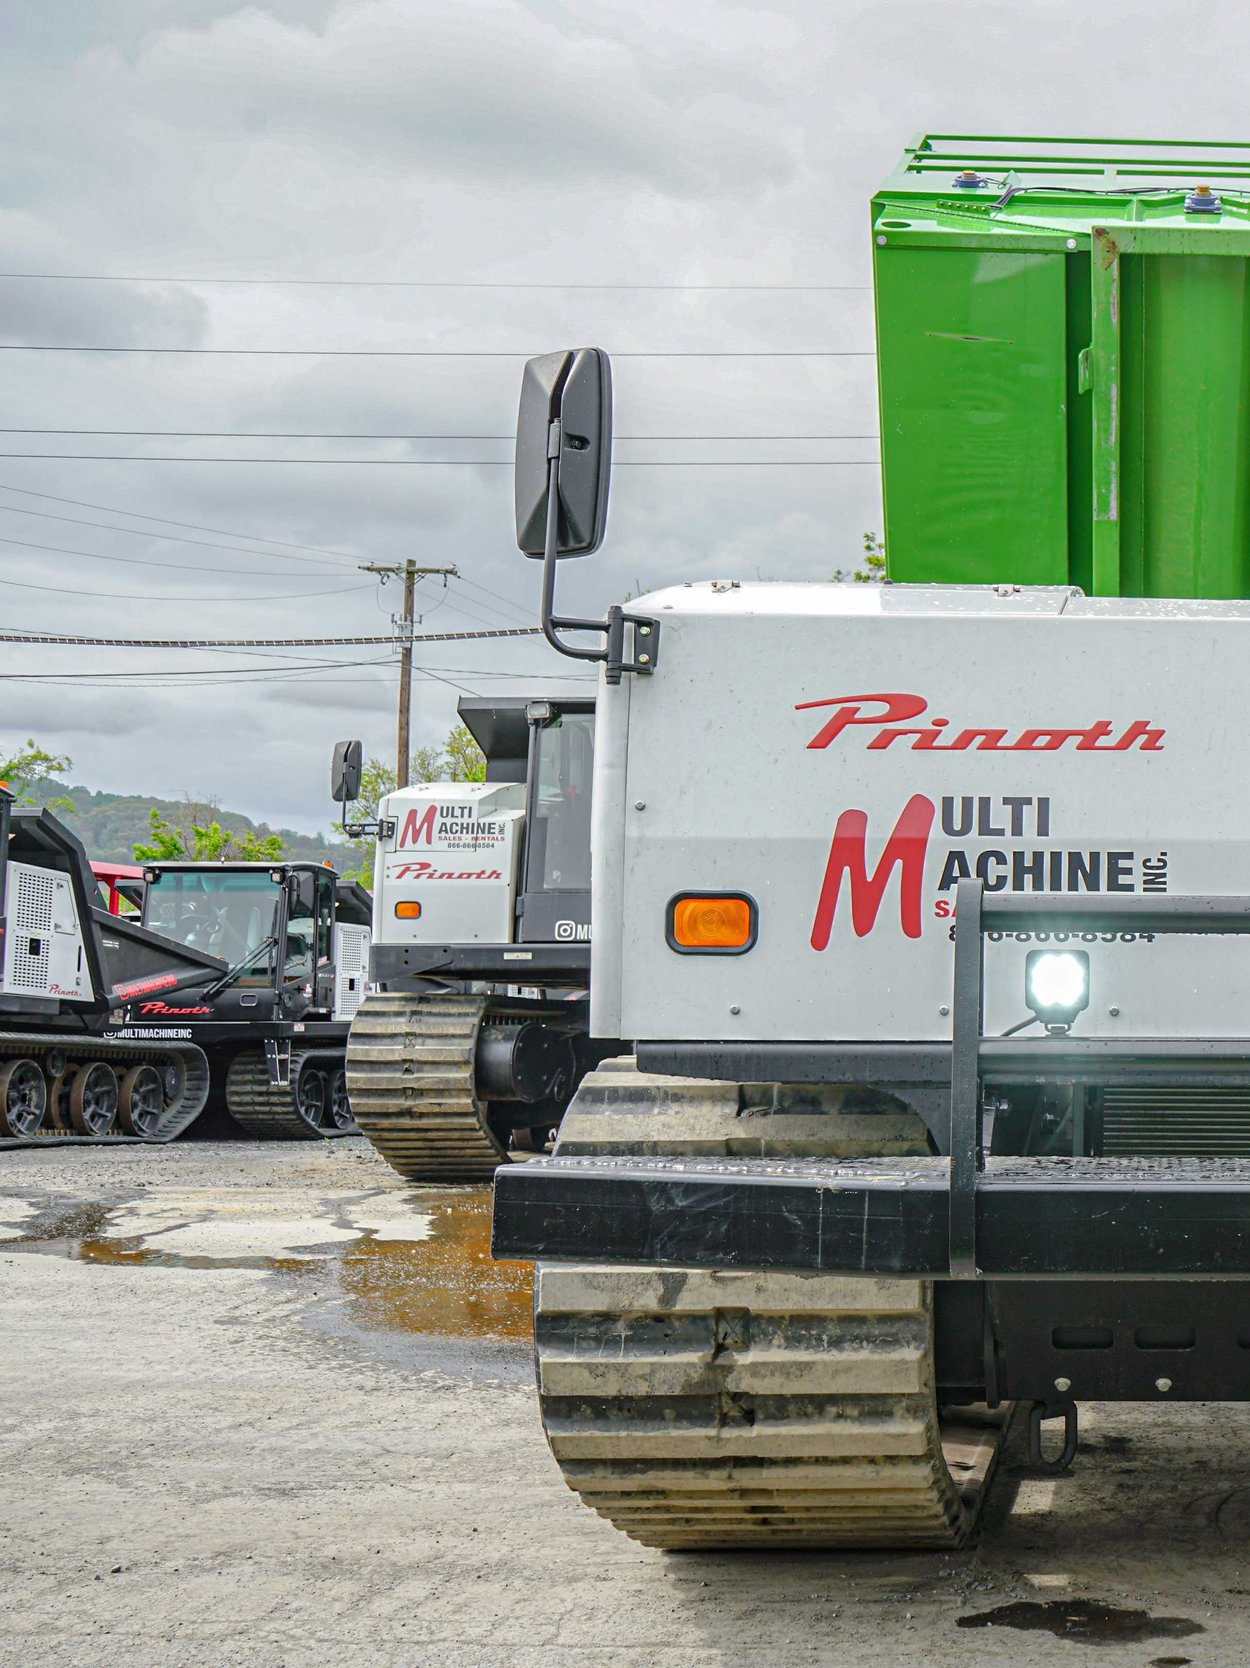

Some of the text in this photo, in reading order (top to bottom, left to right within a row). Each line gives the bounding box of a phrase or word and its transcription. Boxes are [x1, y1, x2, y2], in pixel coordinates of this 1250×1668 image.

[795, 692, 1166, 750] Prinoth
[392, 862, 503, 880] Prinoth
[139, 1001, 212, 1014] Prinoth
[117, 1028, 193, 1039] MULTIMACHINEINC
